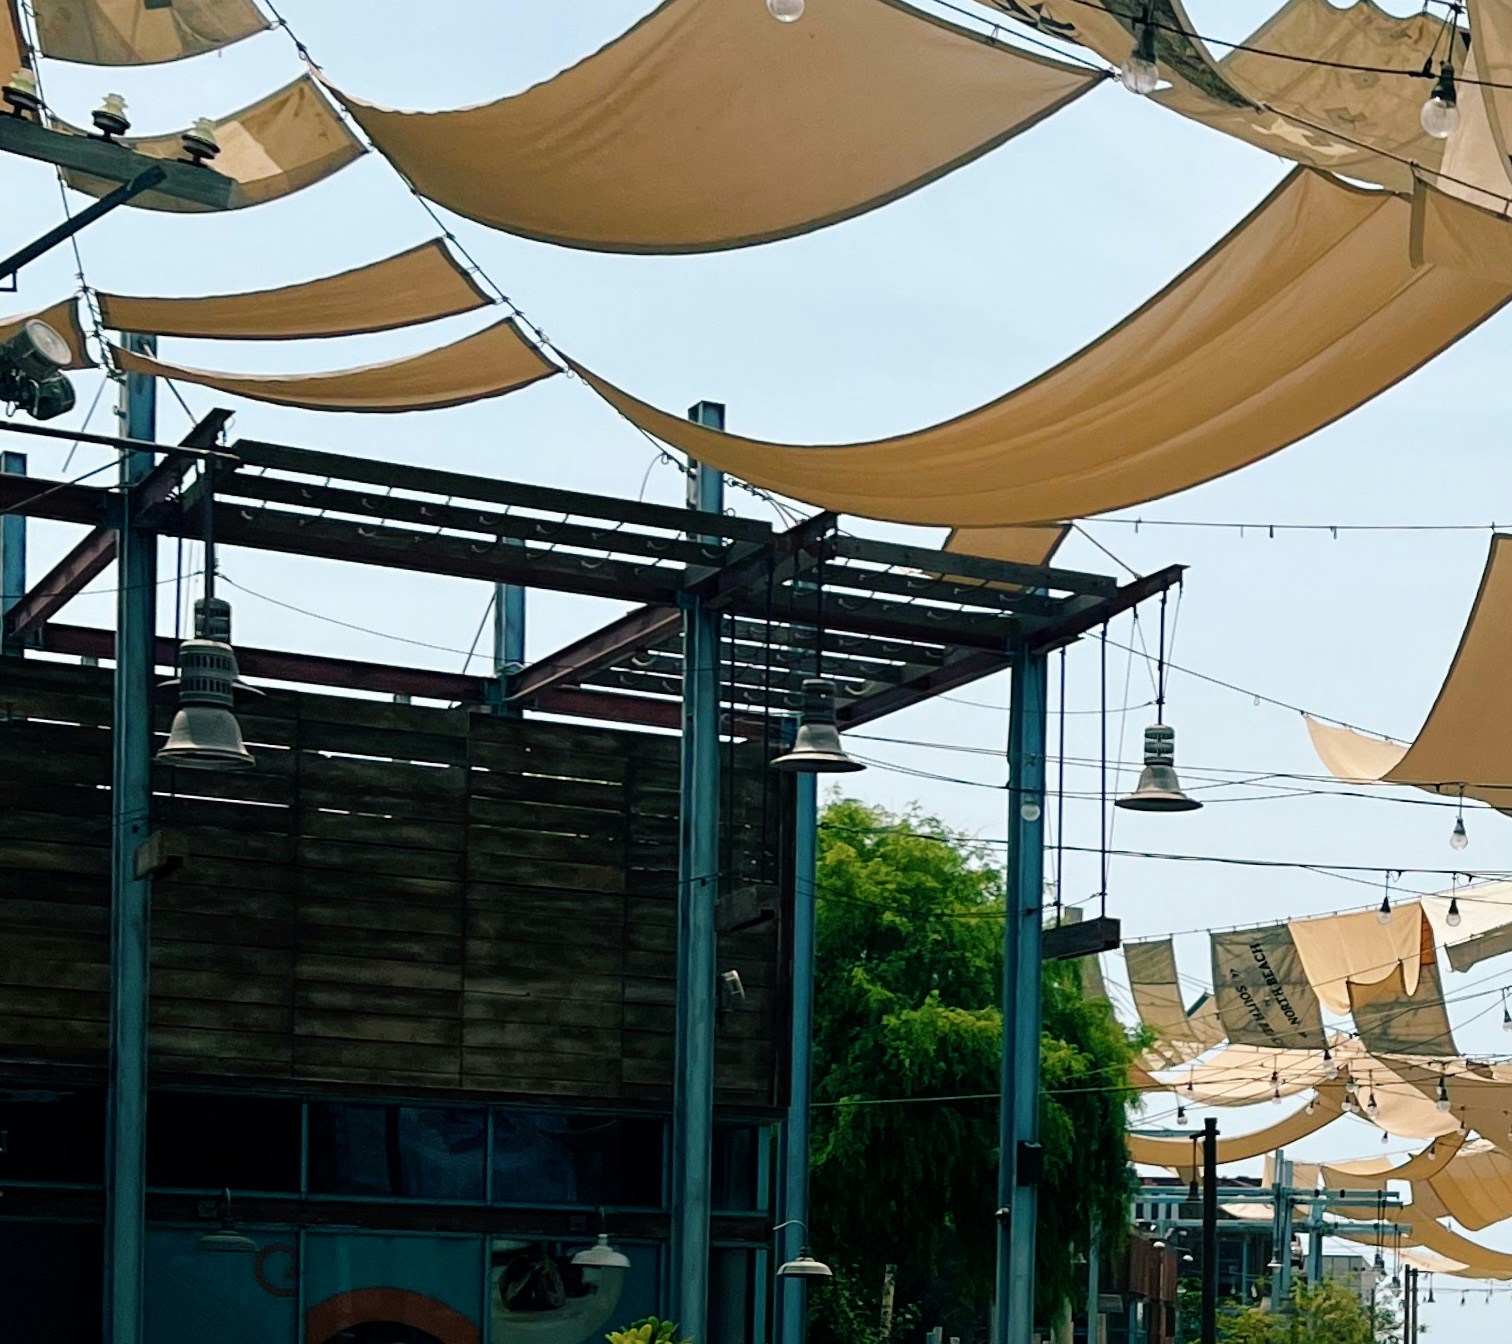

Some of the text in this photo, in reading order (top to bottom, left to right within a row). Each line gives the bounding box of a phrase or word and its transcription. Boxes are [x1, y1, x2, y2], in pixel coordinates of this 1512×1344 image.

[1235, 985, 1265, 1021] SOUTH
[1249, 943, 1299, 1025] NORTH BEACH
